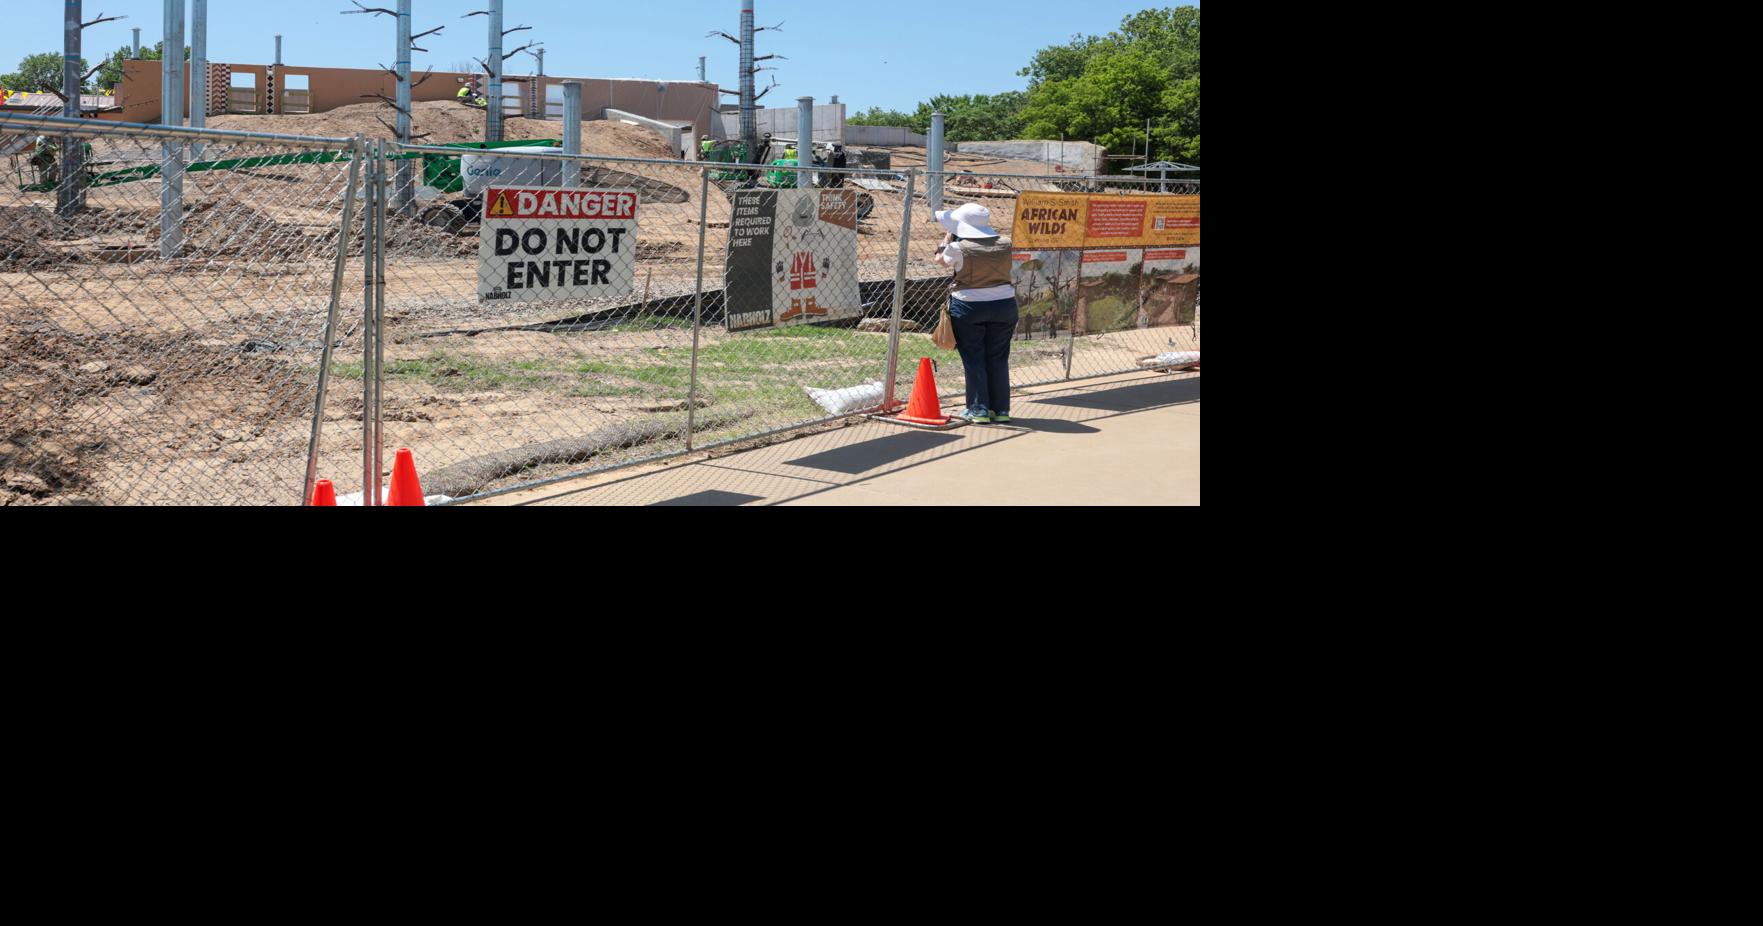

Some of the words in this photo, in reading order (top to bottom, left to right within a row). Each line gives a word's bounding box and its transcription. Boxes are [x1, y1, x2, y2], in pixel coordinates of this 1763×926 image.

[517, 191, 634, 217] DANGER
[738, 196, 761, 205] THESE
[736, 206, 759, 216] ITEMS
[1021, 208, 1078, 221] AFRICAN
[735, 216, 772, 227] REQUIRED
[734, 228, 744, 236] TO
[746, 227, 769, 236] WORK
[1028, 222, 1067, 235] WILDS
[495, 227, 548, 256] DO
[555, 227, 626, 255] NOT
[732, 238, 752, 247] HERE
[507, 259, 612, 290] ENTER
